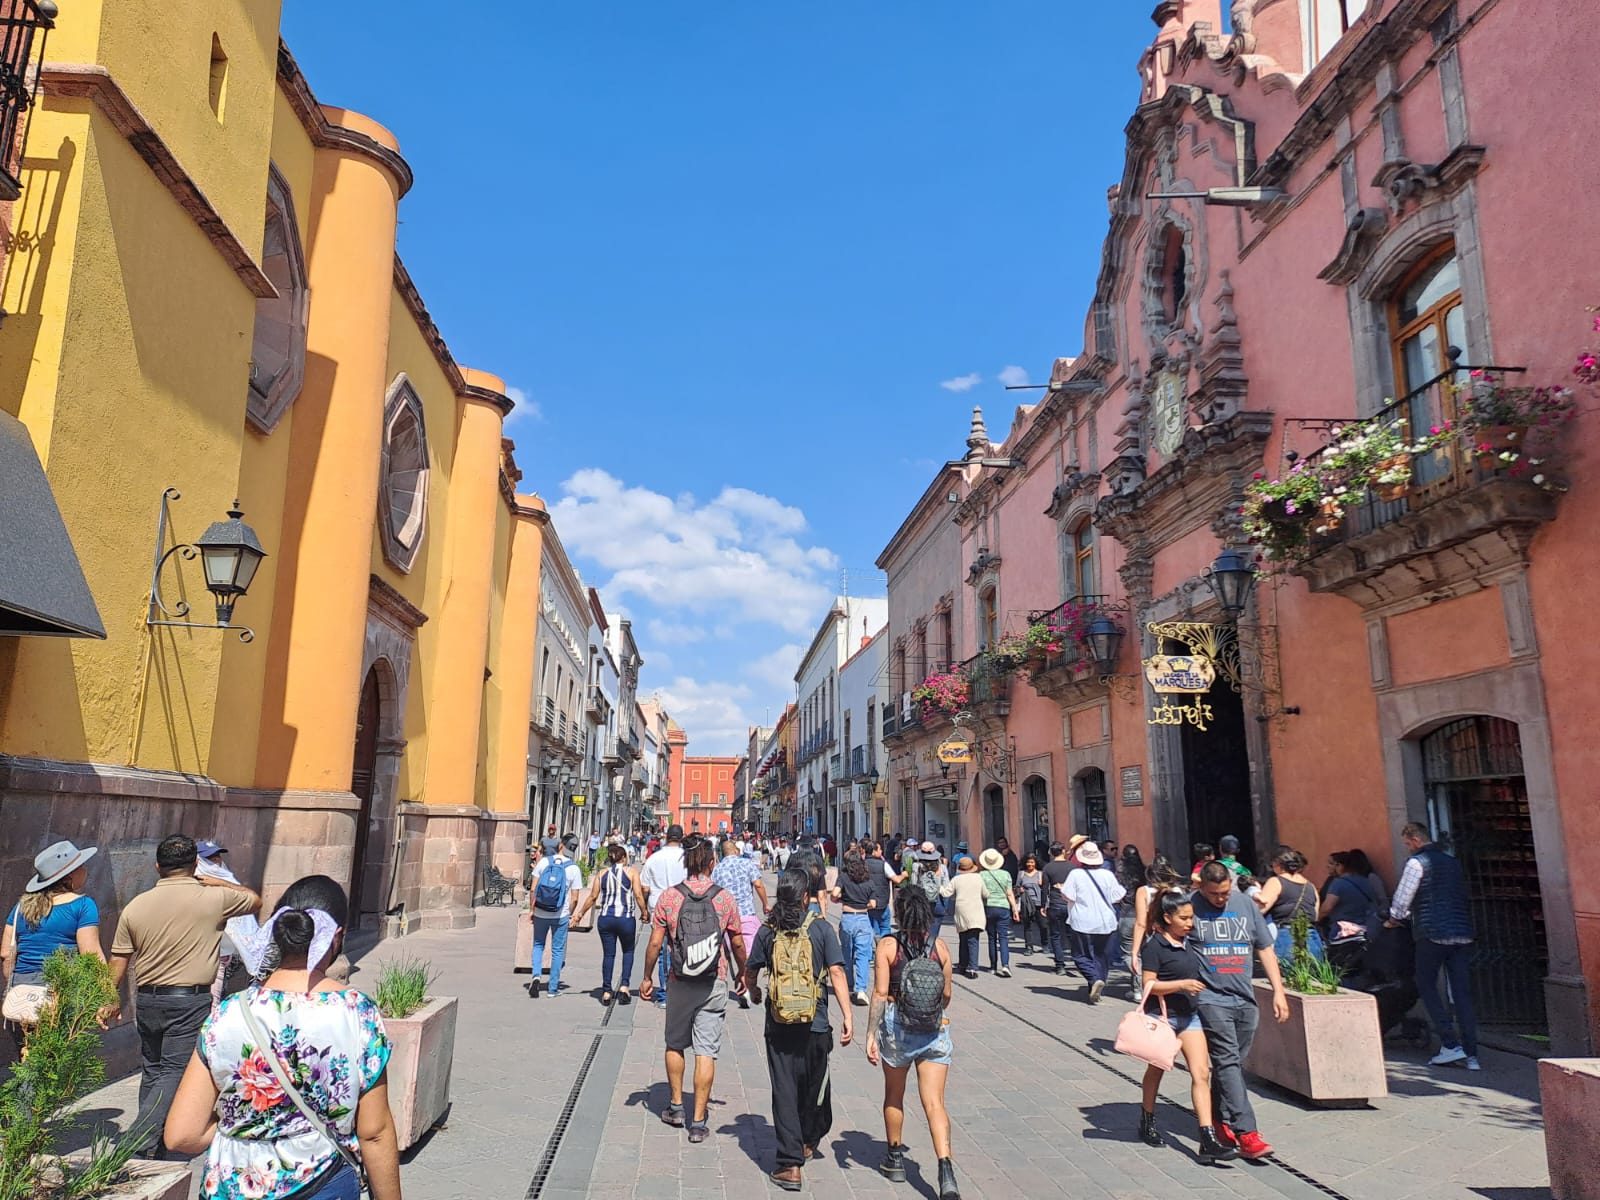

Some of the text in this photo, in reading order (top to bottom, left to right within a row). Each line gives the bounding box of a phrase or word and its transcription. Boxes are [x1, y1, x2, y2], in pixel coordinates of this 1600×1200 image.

[1155, 677, 1209, 689] MARQUESA
[1198, 916, 1250, 942] FOX
[687, 931, 718, 966] NIKE
